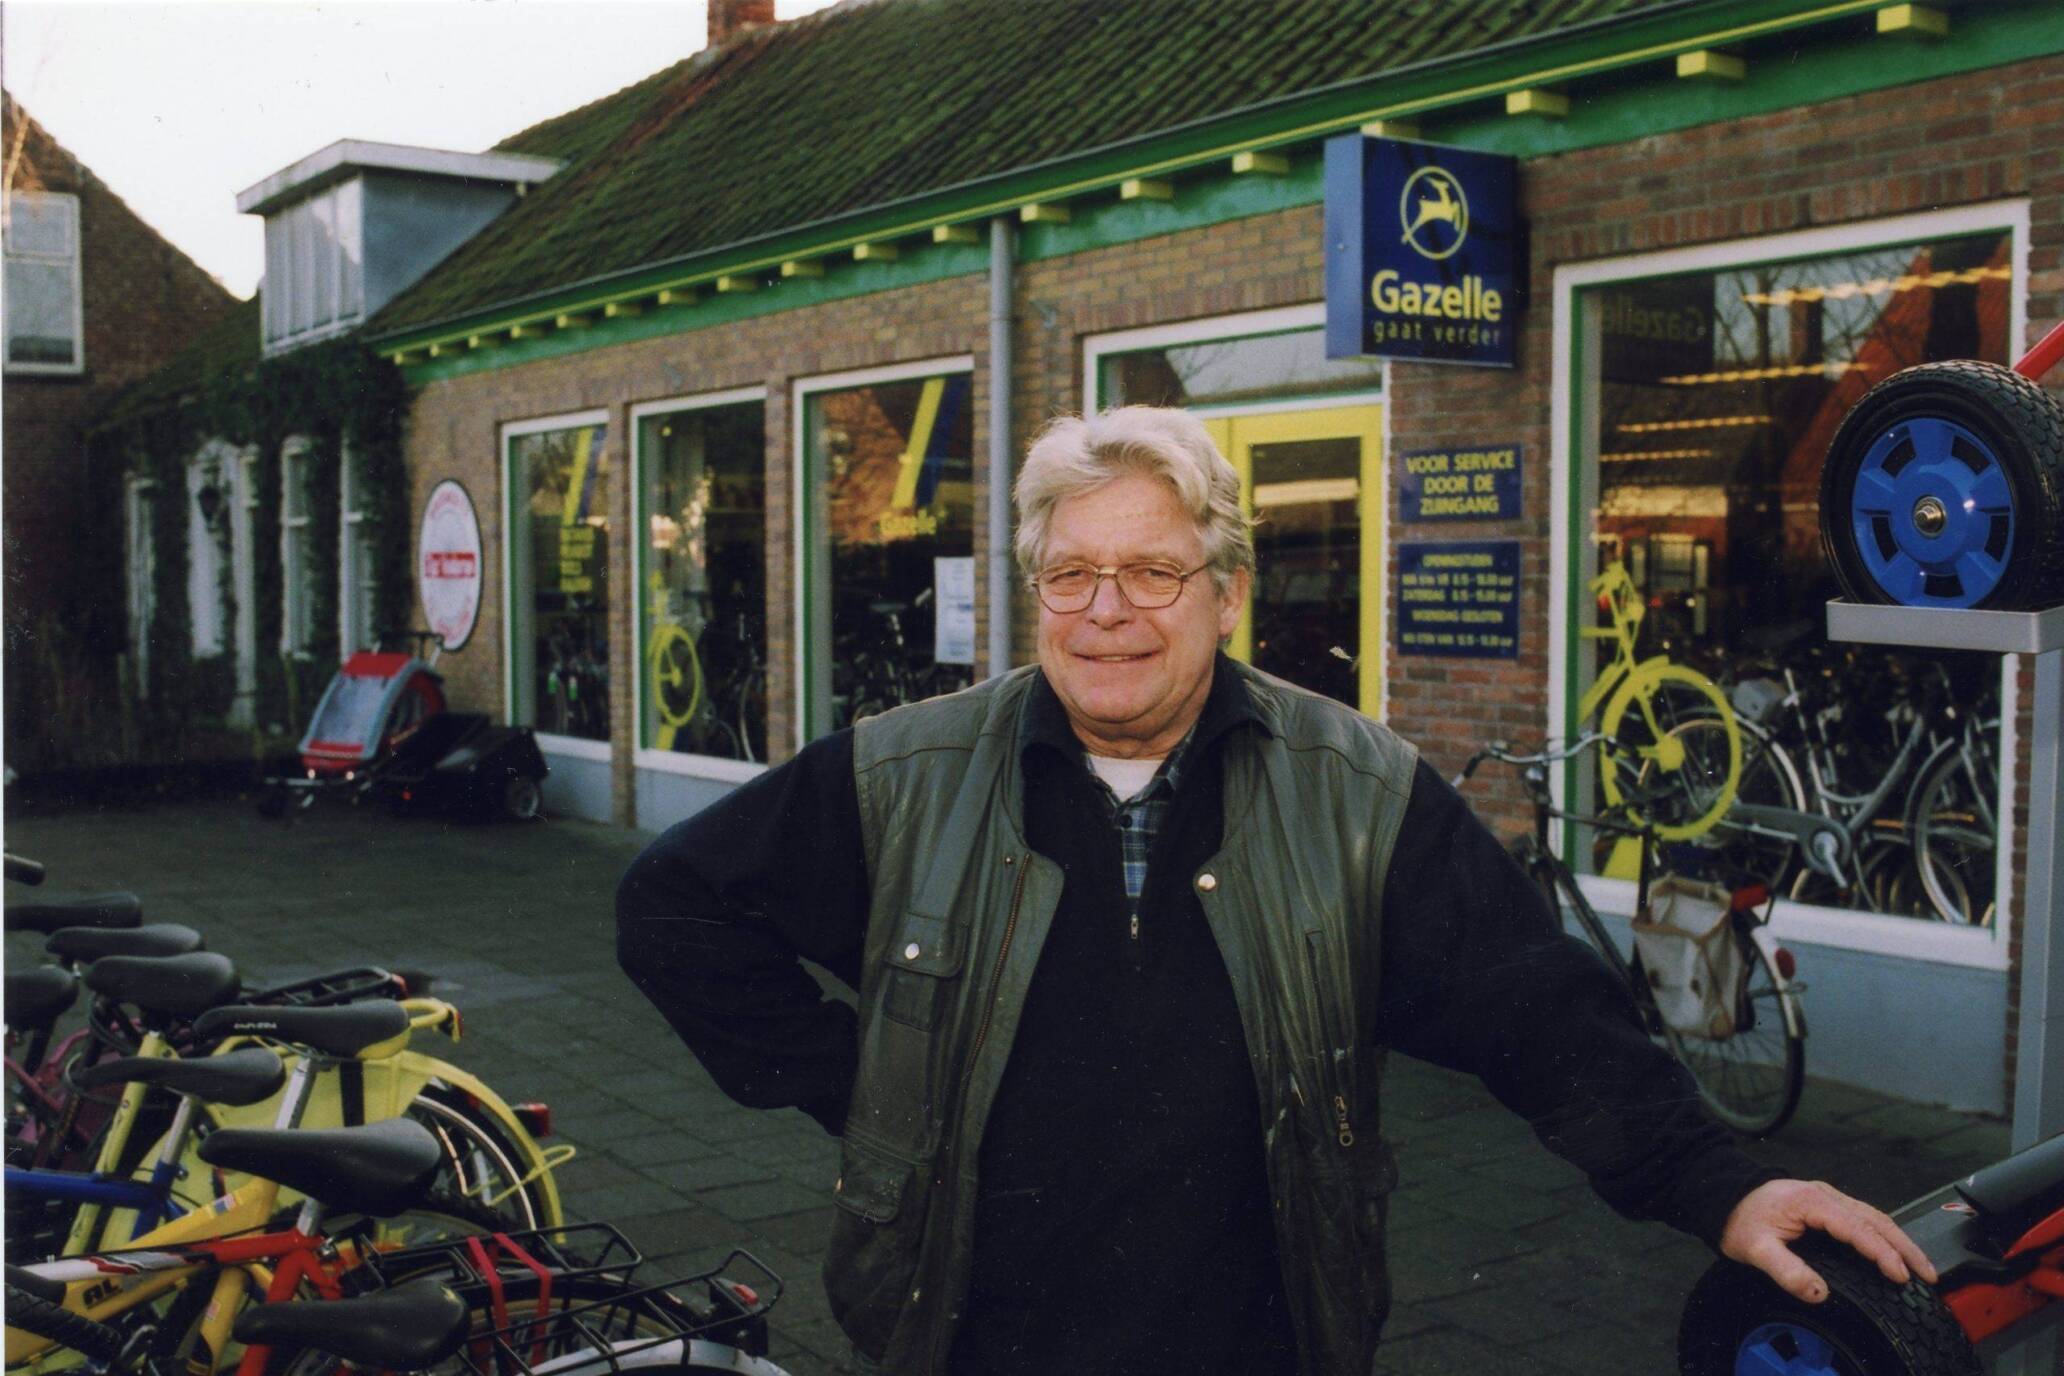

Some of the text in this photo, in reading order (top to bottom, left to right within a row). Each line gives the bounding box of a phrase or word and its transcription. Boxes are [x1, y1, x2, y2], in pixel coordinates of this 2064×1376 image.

[1371, 269, 1502, 322] Gazelle
[1373, 321, 1500, 346] gaat verder
[1406, 452, 1515, 473] VOOR SERVICE
[1424, 474, 1494, 494] DOOR DE
